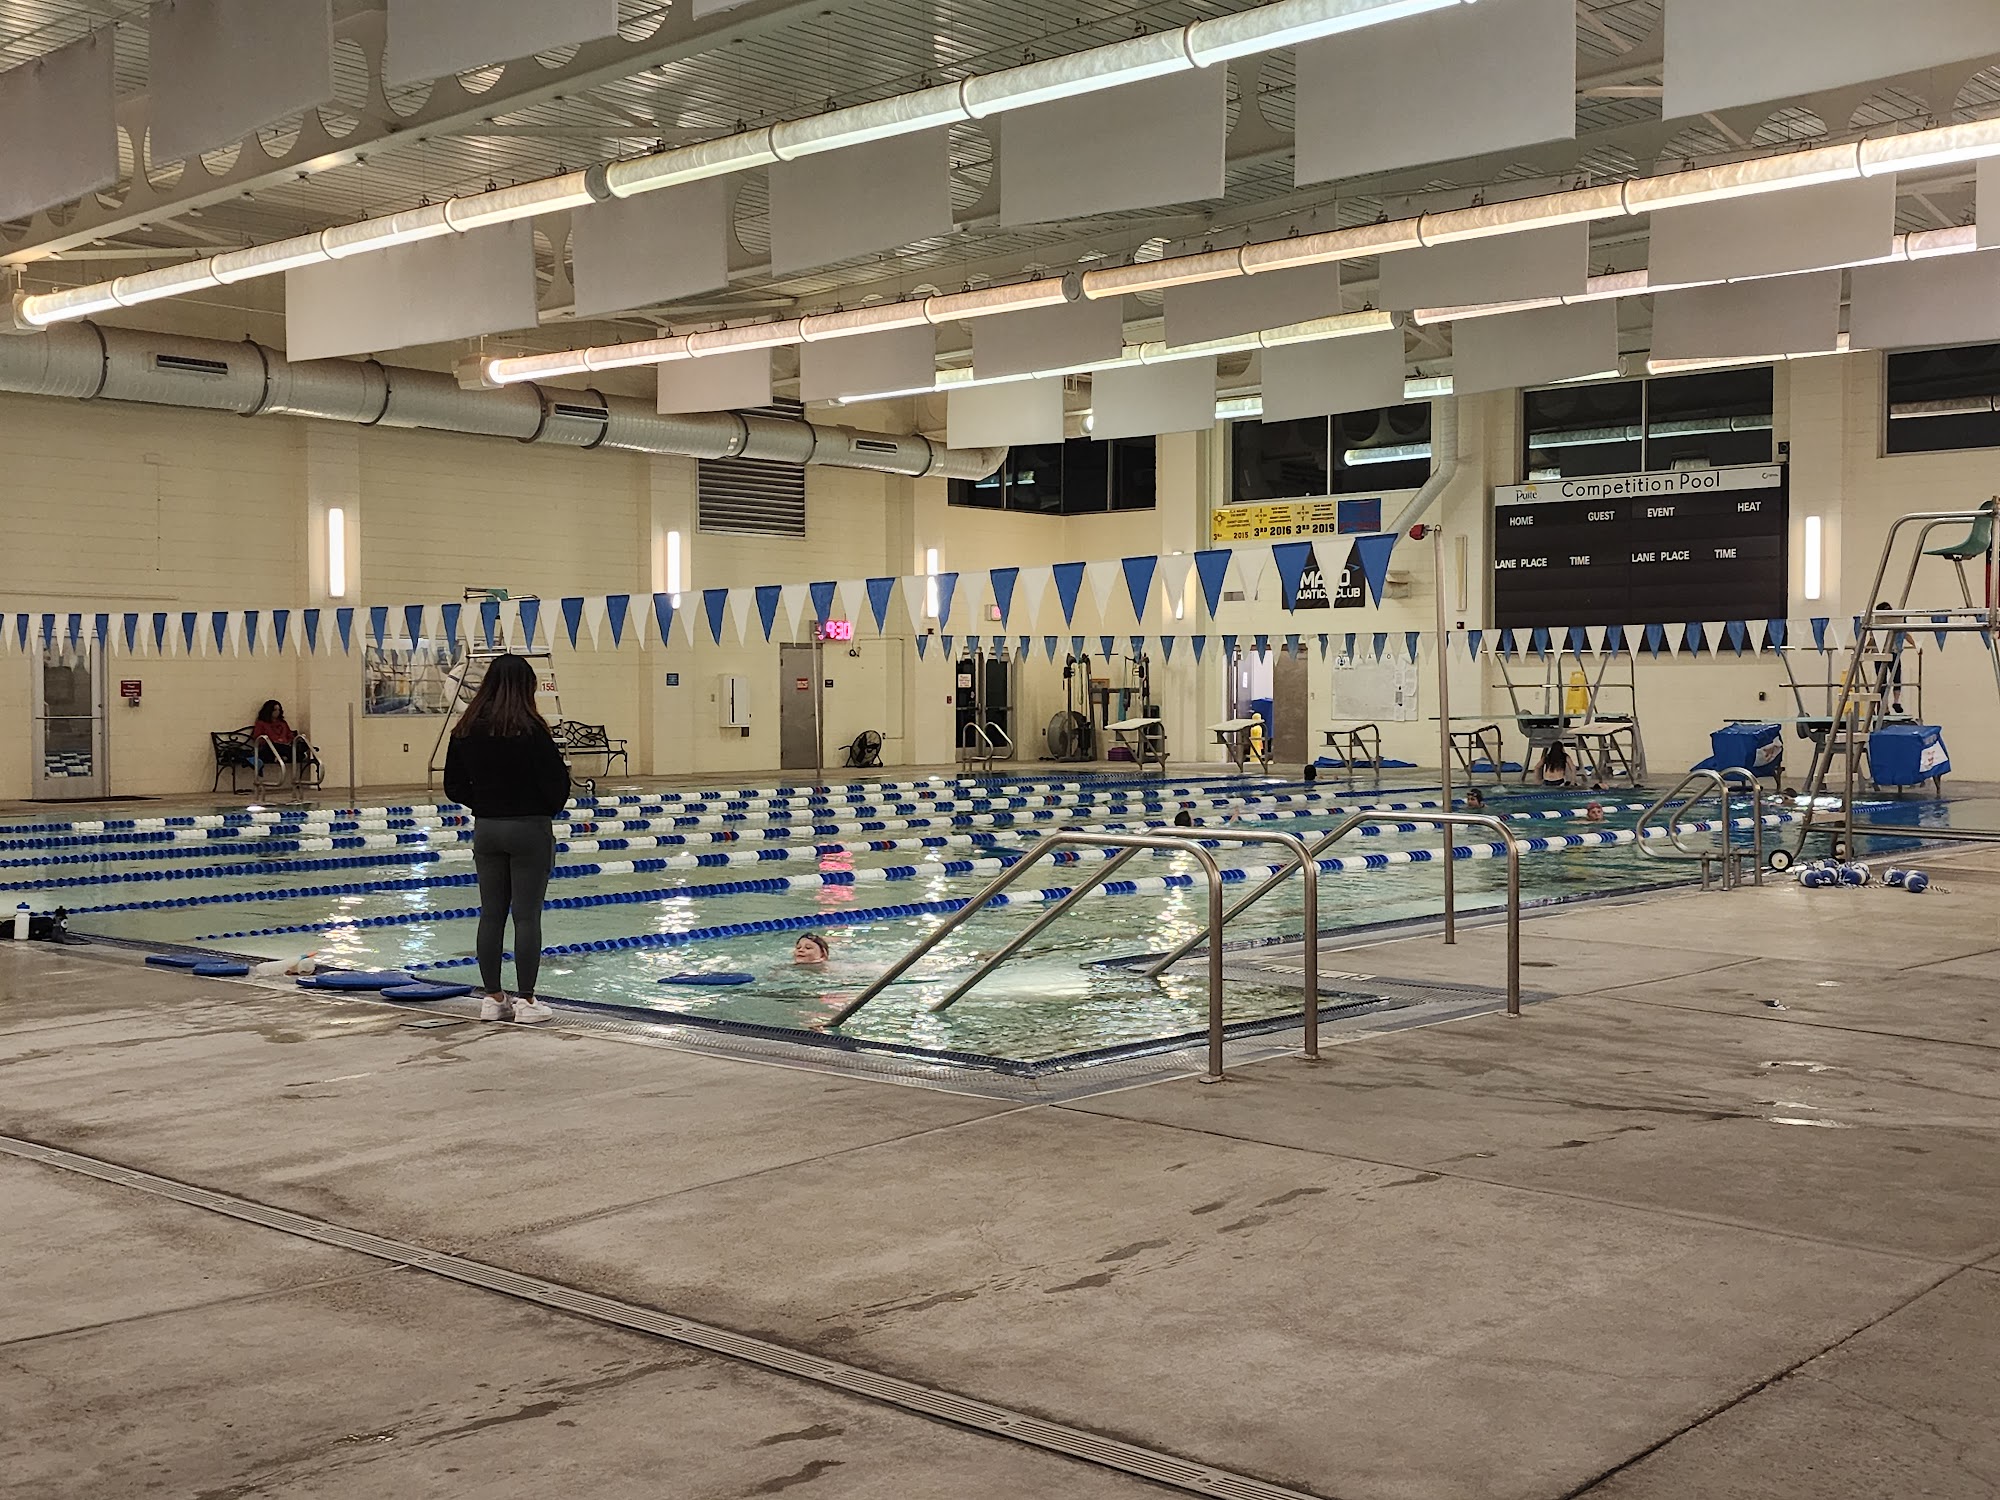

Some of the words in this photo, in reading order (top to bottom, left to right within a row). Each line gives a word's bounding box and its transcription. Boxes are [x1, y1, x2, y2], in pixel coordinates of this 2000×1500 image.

[1561, 478, 1674, 498] Competition
[1680, 471, 1720, 489] Pool
[1737, 501, 1761, 512] HEAT
[1587, 511, 1615, 521] GUEST
[1647, 507, 1675, 517] EVENT
[1509, 516, 1534, 526] HOME
[1269, 525, 1292, 536] 2016
[1312, 523, 1335, 534] 2019
[1233, 531, 1249, 539] 2015
[1631, 552, 1655, 562] LANE
[1660, 550, 1690, 561] PLACE
[1714, 548, 1737, 558] TIME
[1494, 559, 1516, 569] LANE
[1520, 557, 1548, 568] PLACE
[1569, 555, 1590, 565] TIME
